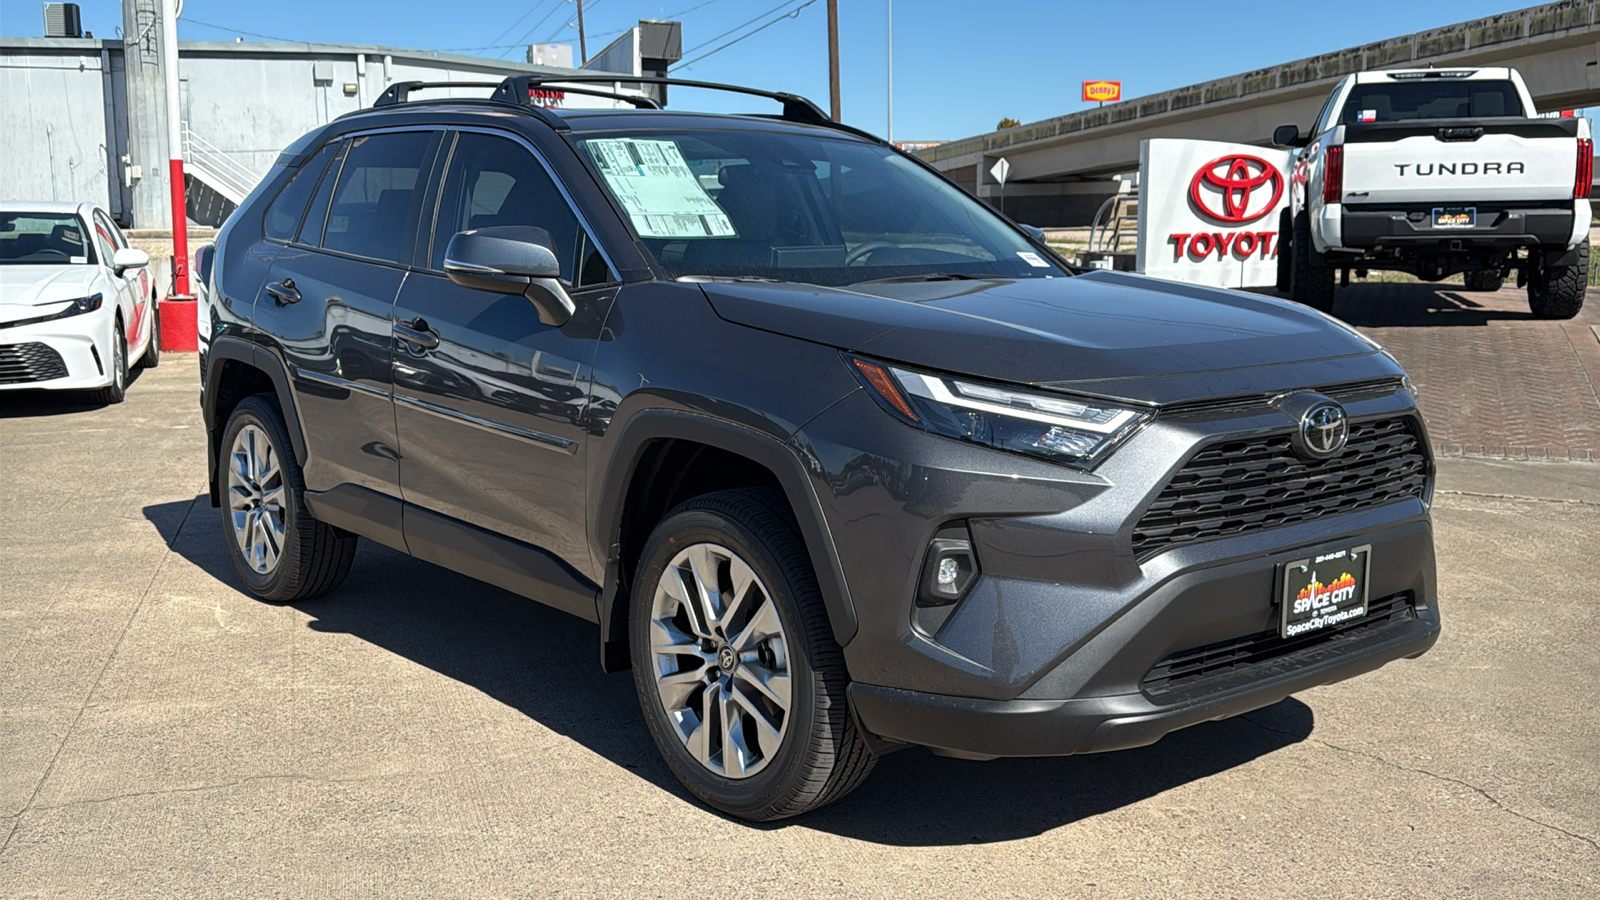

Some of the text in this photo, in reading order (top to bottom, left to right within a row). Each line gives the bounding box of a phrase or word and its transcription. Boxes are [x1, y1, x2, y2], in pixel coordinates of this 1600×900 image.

[1393, 161, 1525, 177] TUNDRA
[1170, 231, 1279, 259] TOYOT
[1293, 585, 1356, 614] SPACE CITY
[1319, 605, 1338, 615] TOYOTA
[1286, 606, 1364, 636] SpaceCityToyota.com
